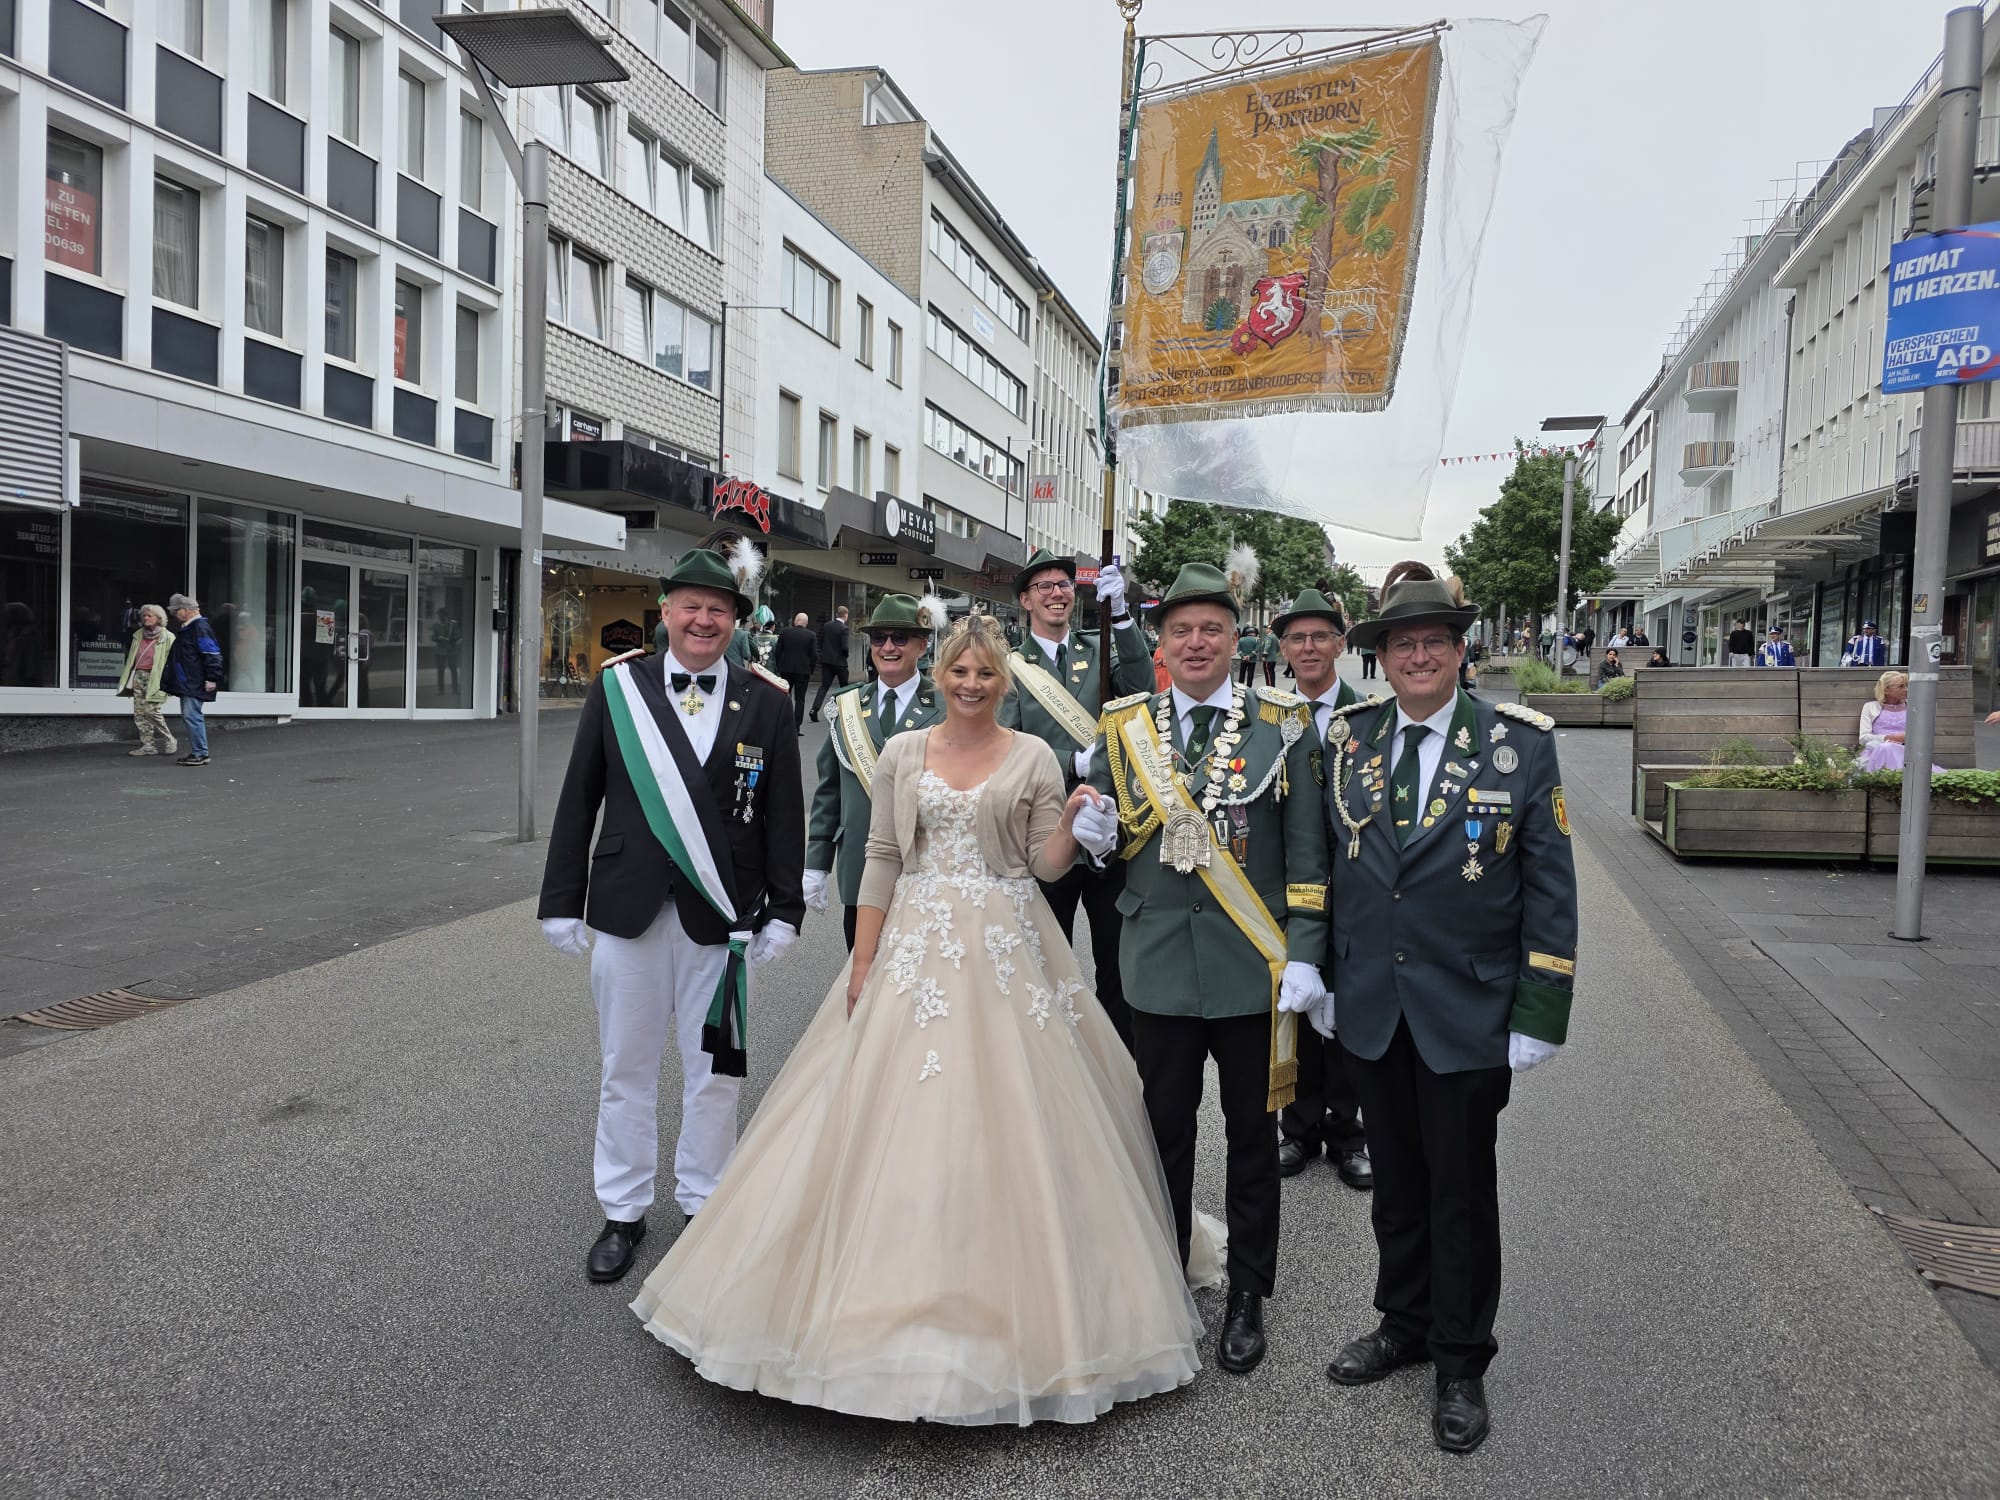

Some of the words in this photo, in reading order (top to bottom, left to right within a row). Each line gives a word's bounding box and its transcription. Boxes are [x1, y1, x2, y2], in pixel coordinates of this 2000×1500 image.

[1246, 79, 1357, 113] ERZBISTUM
[1252, 99, 1362, 137] PADERBORN
[57, 189, 75, 204] ZU
[1893, 247, 1965, 283] HEIMAT
[1892, 283, 1914, 307] IM
[1914, 269, 2000, 301] HERZEN.
[1890, 327, 1977, 355] VERSPRECHEN
[1887, 347, 1935, 368] HALTEN.
[1937, 345, 1991, 369] AfD
[573, 419, 600, 435] carhartt
[900, 508, 934, 534] MEYAS
[81, 641, 122, 649] VERMIETEN
[96, 633, 107, 641] ZU
